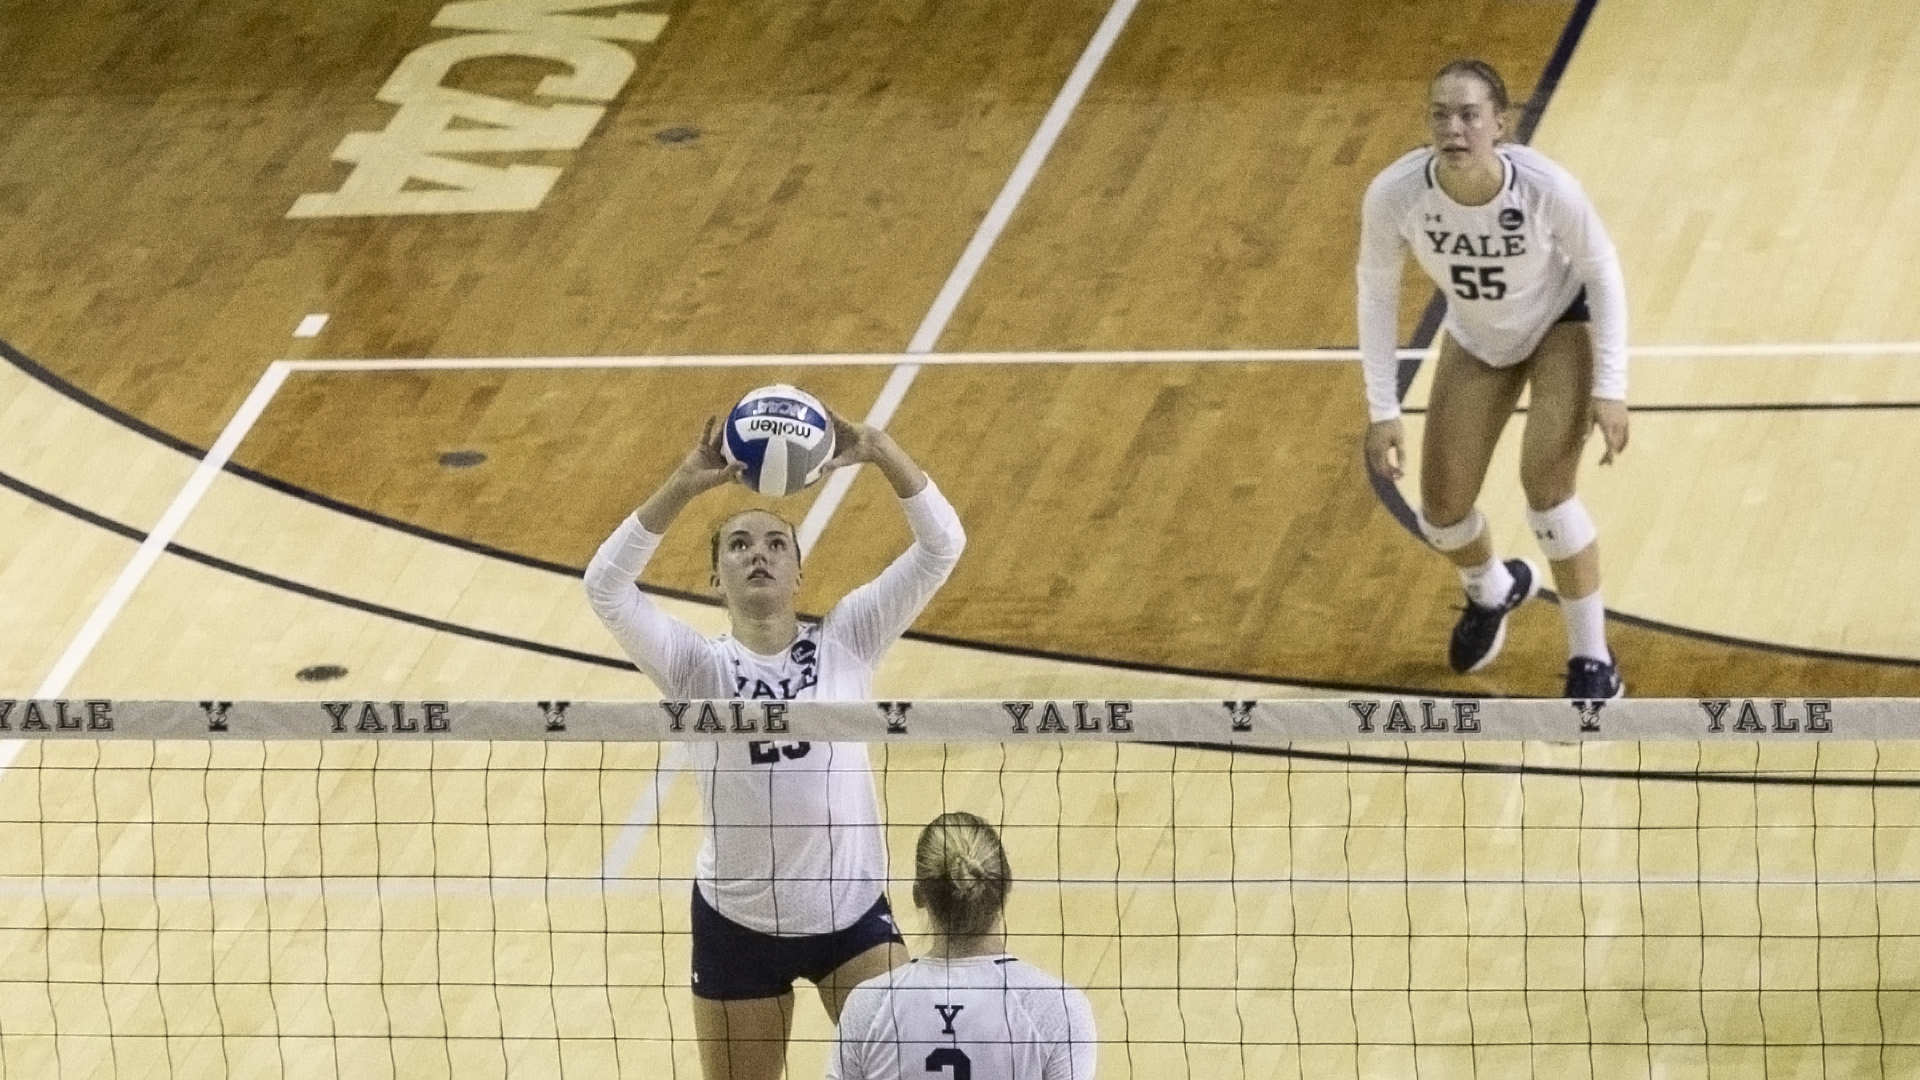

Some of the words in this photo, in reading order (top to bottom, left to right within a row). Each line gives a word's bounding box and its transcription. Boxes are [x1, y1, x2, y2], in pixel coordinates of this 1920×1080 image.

[1425, 230, 1526, 257] YALE
[1451, 265, 1507, 300] 55
[750, 419, 811, 439] molten
[321, 700, 451, 733] YALE
[661, 700, 790, 733] YALE
[1002, 701, 1134, 733] YALE
[1349, 700, 1481, 732] YALE
[1701, 700, 1833, 733] YALE
[935, 1005, 964, 1034] Y
